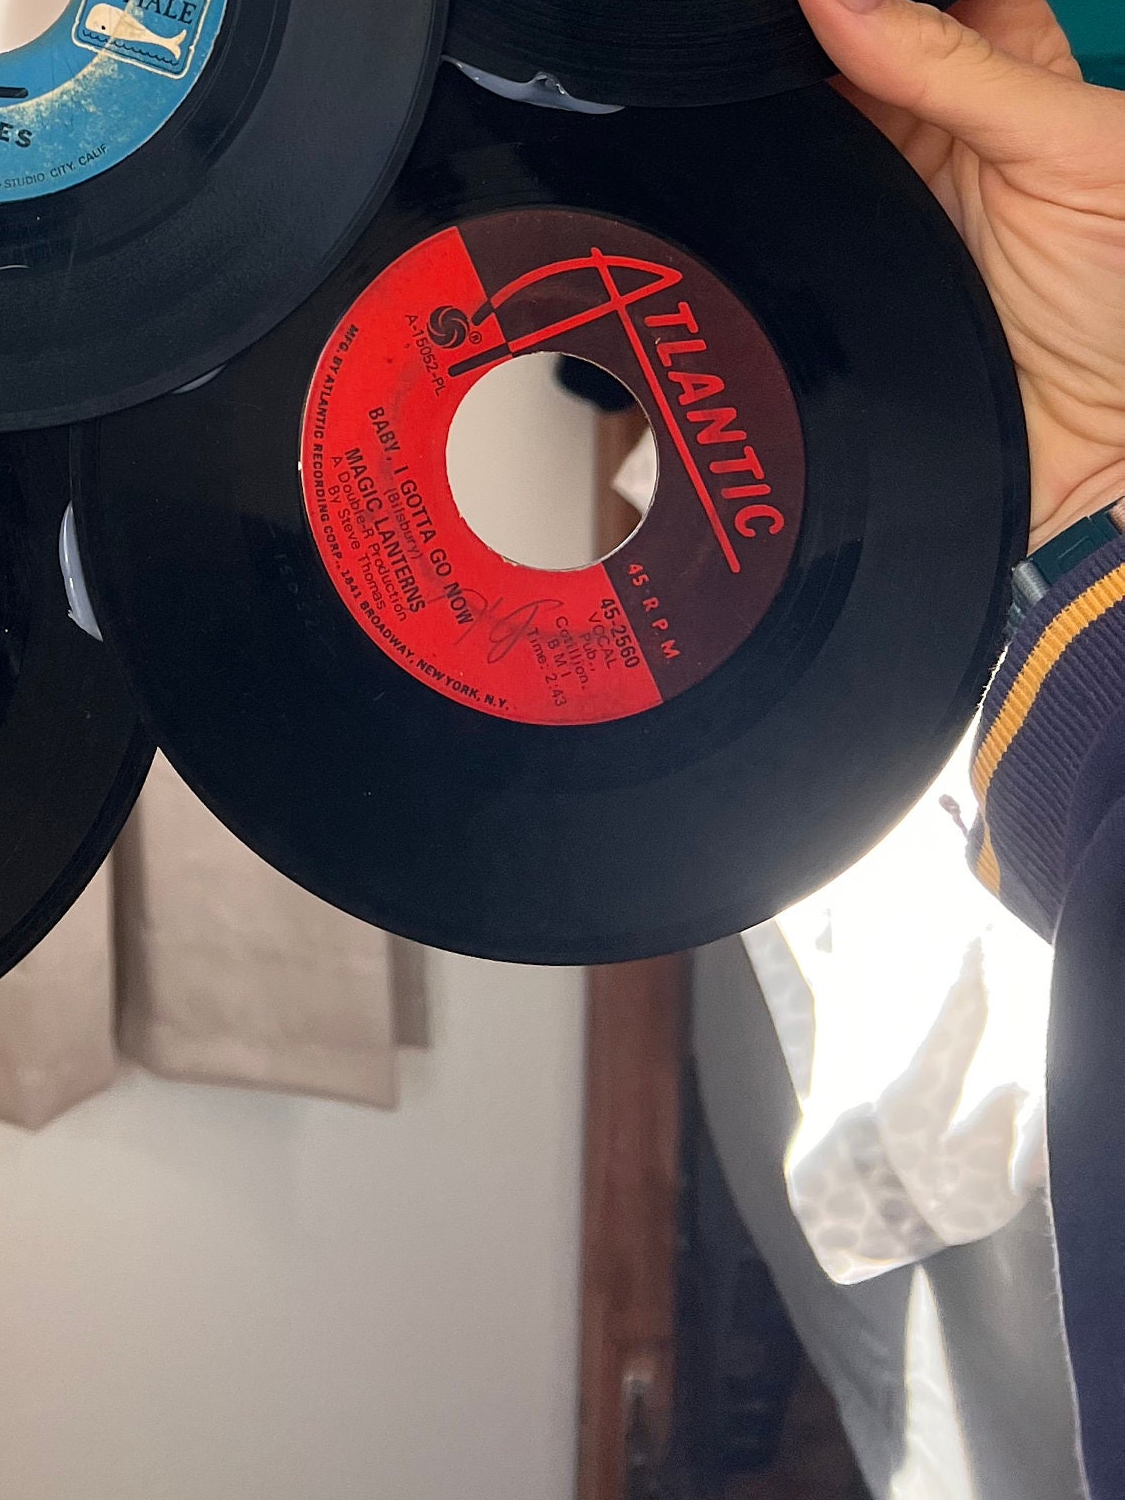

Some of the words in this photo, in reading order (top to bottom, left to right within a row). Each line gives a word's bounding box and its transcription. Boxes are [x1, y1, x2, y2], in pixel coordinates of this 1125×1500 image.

[3, 172, 45, 189] STUDIO
[331, 357, 343, 375] BY
[337, 324, 359, 354] MFG.
[404, 314, 446, 396] A-15052-PL
[313, 374, 335, 440] ATLANTIC
[447, 246, 786, 575] ATLANTIC
[313, 443, 330, 523] RECORDING
[393, 465, 409, 475] I
[330, 455, 343, 468] A
[337, 470, 375, 540] Double-R
[367, 542, 407, 623] Production
[344, 447, 383, 514] MAGIC
[373, 515, 426, 613] LANTERNS
[383, 487, 424, 560] (Bilsbury)
[400, 479, 437, 545] GOTTA
[327, 484, 342, 505] By
[337, 508, 361, 551] Steve
[357, 554, 387, 611] Thomas
[429, 548, 453, 578] GO
[628, 563, 650, 587] 45
[341, 569, 362, 600] 1841
[443, 581, 474, 625] NOW
[359, 600, 415, 665] BROADWAY,
[588, 611, 617, 670] VOCAL
[600, 598, 641, 669] 45-2560
[416, 658, 445, 681] NEW
[445, 675, 481, 702] YORK,
[527, 627, 549, 670] Time:
[545, 672, 567, 707] 2:43
[484, 693, 510, 711] N.Y.
